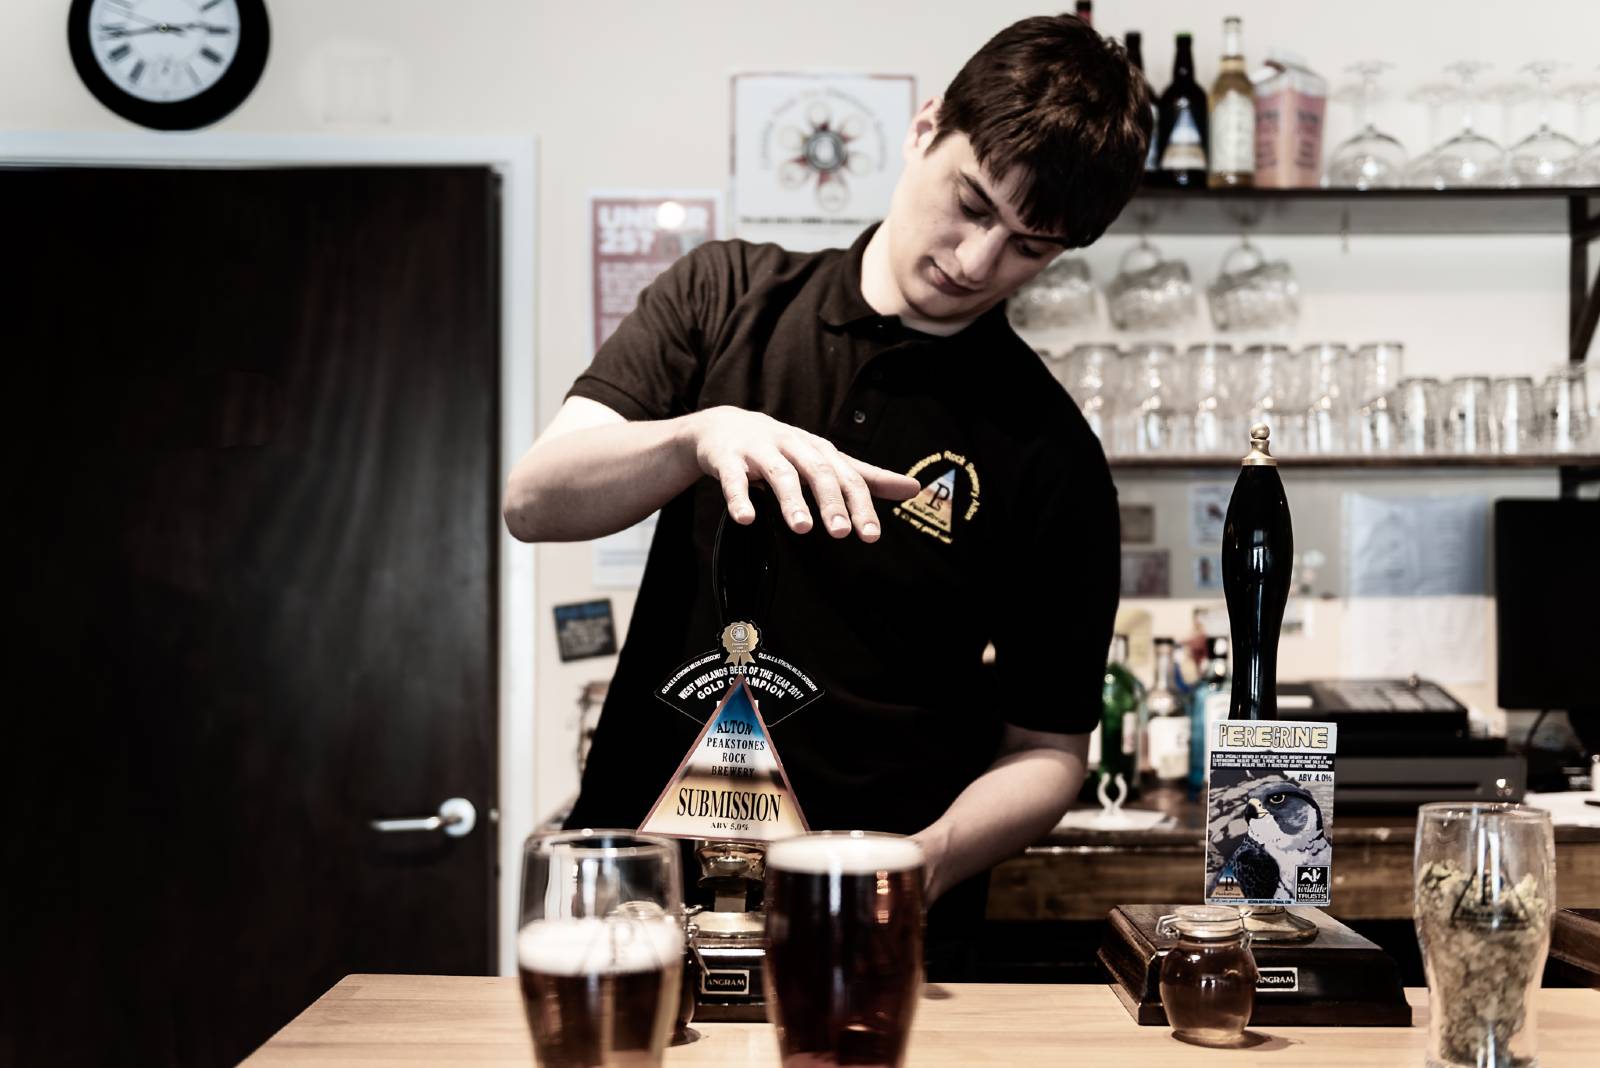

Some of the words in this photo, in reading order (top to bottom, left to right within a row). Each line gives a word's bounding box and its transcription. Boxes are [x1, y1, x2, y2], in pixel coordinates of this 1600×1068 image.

[678, 682, 697, 700] WEST
[694, 666, 729, 688] MIDLANDS
[729, 665, 748, 675] BEER
[748, 665, 759, 676] OF
[759, 667, 774, 681] THE
[773, 673, 791, 690] YEAR
[787, 684, 805, 700] 2017
[696, 679, 725, 700] GOLD
[728, 675, 786, 699] CAMPION
[716, 719, 754, 736] ALTON
[1219, 724, 1329, 749] PEREGRINE
[706, 737, 765, 751] PEAKSTONES
[722, 752, 746, 764] ROCK
[711, 765, 755, 778] BREWERY
[1298, 773, 1312, 782] ABV
[1314, 773, 1333, 783] 4.0%
[676, 787, 782, 822] SUBMISSION
[711, 821, 727, 830] ABV
[729, 822, 749, 831] 5.0%
[706, 978, 746, 986] ANGRAM
[1255, 975, 1295, 984] ANGRAM
